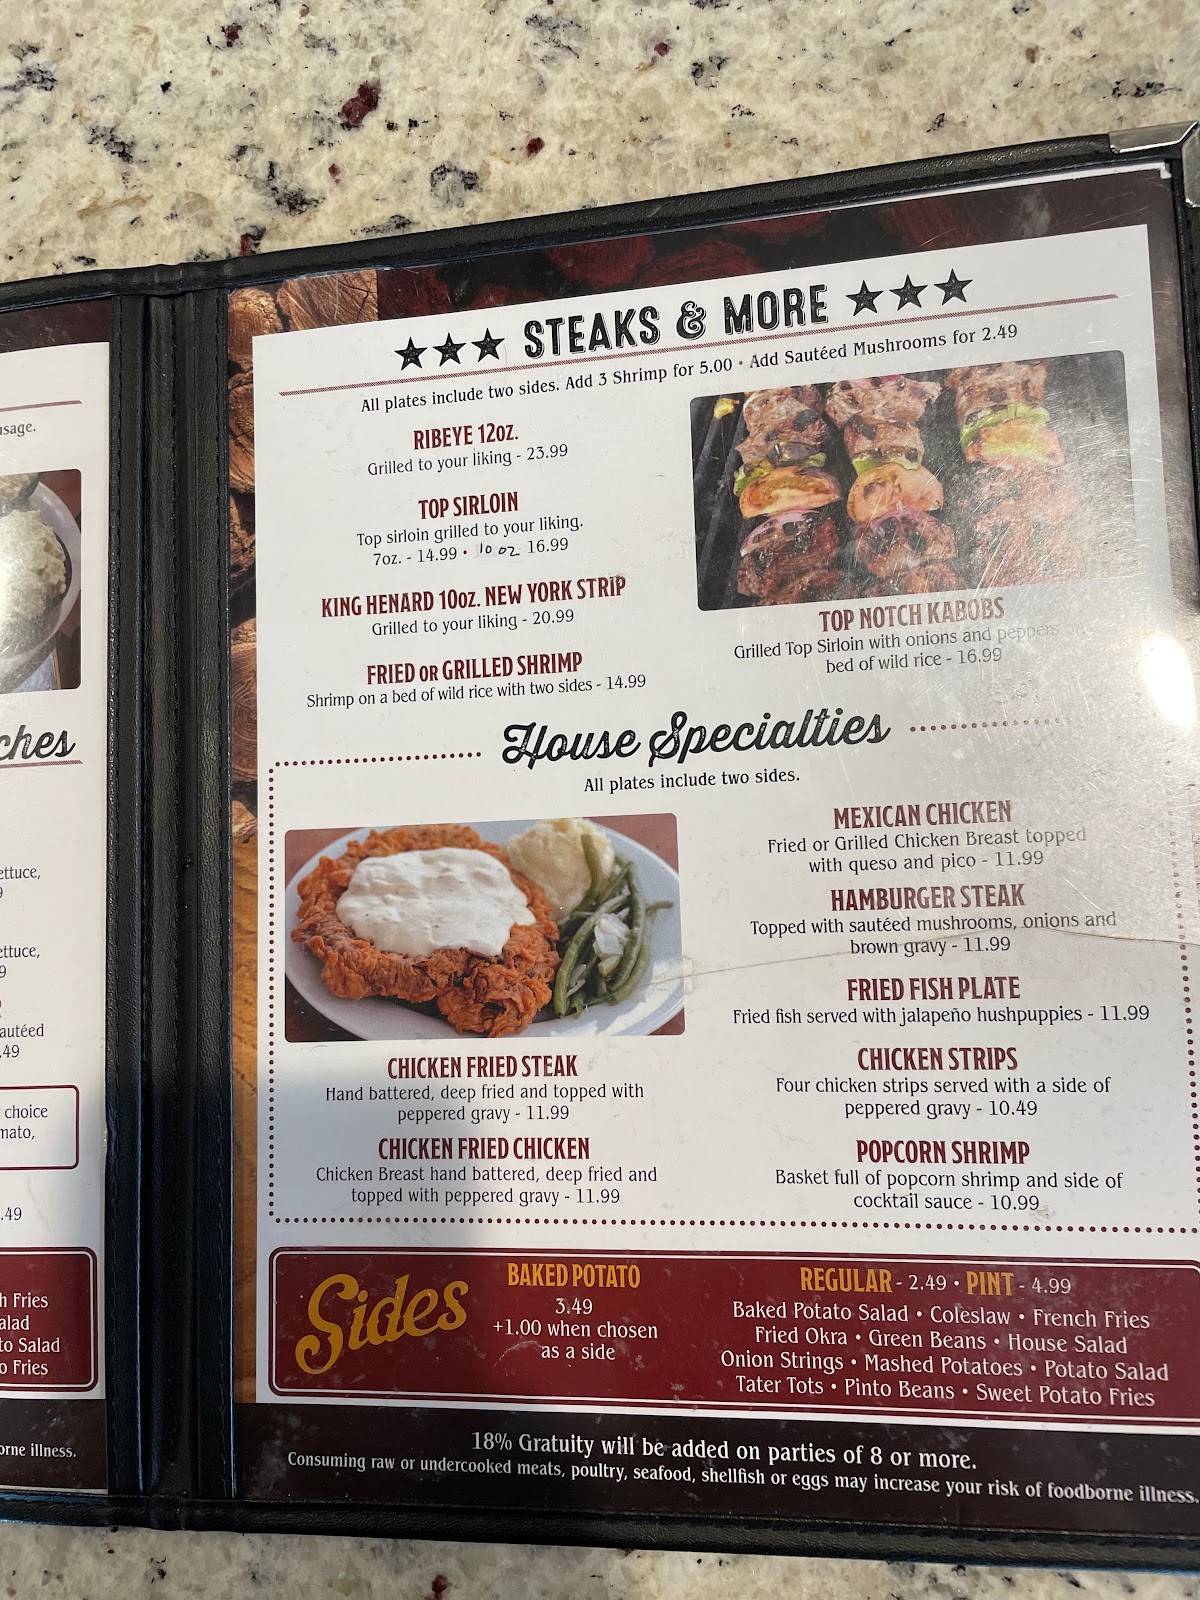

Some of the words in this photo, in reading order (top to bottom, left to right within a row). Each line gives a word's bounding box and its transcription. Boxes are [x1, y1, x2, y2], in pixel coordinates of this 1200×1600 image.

[523, 305, 661, 360] STEAKS
[675, 300, 707, 340] &
[723, 283, 829, 336] MORE
[361, 397, 380, 413] All
[385, 394, 427, 414] plates
[432, 387, 483, 405] include
[488, 385, 514, 399] two
[519, 380, 560, 395] sides.
[565, 373, 593, 390] Add
[599, 372, 607, 386] 3
[613, 368, 667, 385] Shrimp
[673, 363, 694, 378] for
[700, 358, 733, 375] 5.00
[749, 351, 779, 369] Add
[784, 343, 847, 364] Sautéed
[853, 335, 947, 356] Mushrooms
[952, 329, 976, 345] for
[981, 324, 1018, 342] 2.49
[413, 425, 473, 451] RIBEYE
[477, 422, 519, 444] 12oz.
[367, 458, 413, 476] Grilled
[418, 458, 433, 471] to
[437, 456, 469, 473] your
[473, 450, 512, 467] liking
[527, 443, 568, 461] 23.99
[417, 497, 450, 520] TOP
[453, 491, 519, 517] SIRLOIN
[373, 553, 402, 566] 7oz.
[418, 546, 457, 563] 14.99
[528, 537, 569, 554] 16.99
[321, 595, 362, 618] KING
[366, 590, 434, 615] HENARD
[484, 583, 523, 607] NEW
[526, 579, 573, 603] YORK
[576, 575, 626, 600] STRIP
[818, 609, 855, 633] TOP
[859, 603, 923, 630] NOTCH
[926, 596, 1005, 625] KABOBS
[734, 642, 781, 659] Grilled
[787, 642, 813, 658] Top
[817, 636, 864, 653] Sirloin
[868, 633, 901, 650] with
[905, 629, 957, 646] onions
[962, 627, 992, 643] and
[367, 662, 416, 685] FRIED
[442, 656, 514, 681] GRILLED
[516, 651, 583, 676] SHRIMP
[501, 721, 642, 770] House
[648, 707, 892, 768] Specialties
[833, 804, 922, 830] MEXICAN
[925, 799, 1012, 826] CHICKEN
[830, 885, 957, 912] HAMBURGER
[959, 883, 1026, 908] STEAK
[846, 977, 905, 1001] FRIED
[909, 977, 954, 1001] FISH
[957, 975, 1021, 1000] PLATE
[733, 1008, 770, 1024] Fried
[775, 1008, 802, 1024] fish
[806, 1008, 858, 1024] served
[863, 1008, 897, 1024] with
[899, 1007, 971, 1027] jalapeño
[977, 1007, 1083, 1026] hushpuppies
[1101, 1005, 1150, 1021] 11.99
[387, 1056, 462, 1080] CHICKEN
[466, 1055, 518, 1078] FRIED
[521, 1054, 578, 1078] STEAK
[857, 1047, 944, 1071] CHICKEN
[947, 1046, 1018, 1071] STRIPS
[4, 1104, 48, 1119] choice
[378, 1137, 453, 1160] CHICKEN
[457, 1137, 509, 1160] FRIED
[513, 1137, 590, 1160] CHICKEN
[855, 1139, 947, 1164] POPCORN
[951, 1140, 1030, 1165] SHRIMP
[316, 1166, 373, 1182] Chicken
[378, 1166, 425, 1181] Breast
[430, 1166, 466, 1181] hand
[472, 1166, 539, 1183] battered,
[545, 1166, 583, 1186] deep
[588, 1165, 623, 1182] fried
[628, 1166, 657, 1182] and
[507, 1262, 569, 1287] BAKED
[572, 1263, 641, 1289] POTATO
[800, 1266, 893, 1294] REGULAR
[909, 1275, 946, 1290] 2.49
[967, 1271, 1014, 1296] PINT
[1032, 1277, 1072, 1294] 4.99
[13, 1291, 49, 1308] Fries
[555, 1297, 593, 1315] 3.49
[295, 1273, 469, 1375] Sides
[492, 1318, 542, 1336] +1.00
[547, 1319, 591, 1337] when
[597, 1320, 658, 1339] chosen
[733, 1301, 787, 1319] Baked
[793, 1302, 852, 1321] Potato
[858, 1303, 909, 1322] Salad
[930, 1305, 1011, 1325] Coleslaw
[1033, 1308, 1097, 1328] French
[1104, 1310, 1151, 1329] Fries
[541, 1345, 560, 1359] as
[565, 1346, 575, 1359] a
[581, 1342, 616, 1361] side
[735, 1375, 782, 1393] Tater
[786, 1376, 824, 1395] Tots
[844, 1377, 892, 1397] Pinto
[898, 1380, 955, 1400] Beans
[976, 1383, 1033, 1403] Sweet
[1039, 1385, 1102, 1405] Potato
[1109, 1387, 1156, 1407] Fries
[30, 1442, 77, 1458] illness.
[472, 1431, 513, 1451] 18%
[518, 1433, 595, 1459] Gratuity
[601, 1435, 635, 1456] will
[642, 1437, 665, 1457] be
[671, 1439, 730, 1459] added
[736, 1445, 761, 1460] on
[767, 1442, 836, 1466] parties
[843, 1444, 864, 1465] of
[870, 1446, 883, 1465] 8
[890, 1451, 912, 1467] or
[918, 1452, 977, 1470] more.
[287, 1451, 366, 1473] Consuming
[371, 1457, 395, 1469] raw
[400, 1458, 416, 1470] or
[420, 1456, 512, 1474] undercooked
[517, 1461, 565, 1478] meats,
[571, 1462, 628, 1483] poultry,
[633, 1464, 696, 1484] seafood,
[701, 1467, 765, 1485] shellfish
[770, 1472, 788, 1485] or
[792, 1473, 829, 1491] eggs
[834, 1475, 868, 1493] may
[873, 1473, 940, 1493] increase
[945, 1480, 983, 1498] your
[987, 1479, 1020, 1497] risk
[1025, 1481, 1043, 1498] of
[1047, 1482, 1134, 1502] foodborne
[1139, 1485, 1200, 1504] illness.
